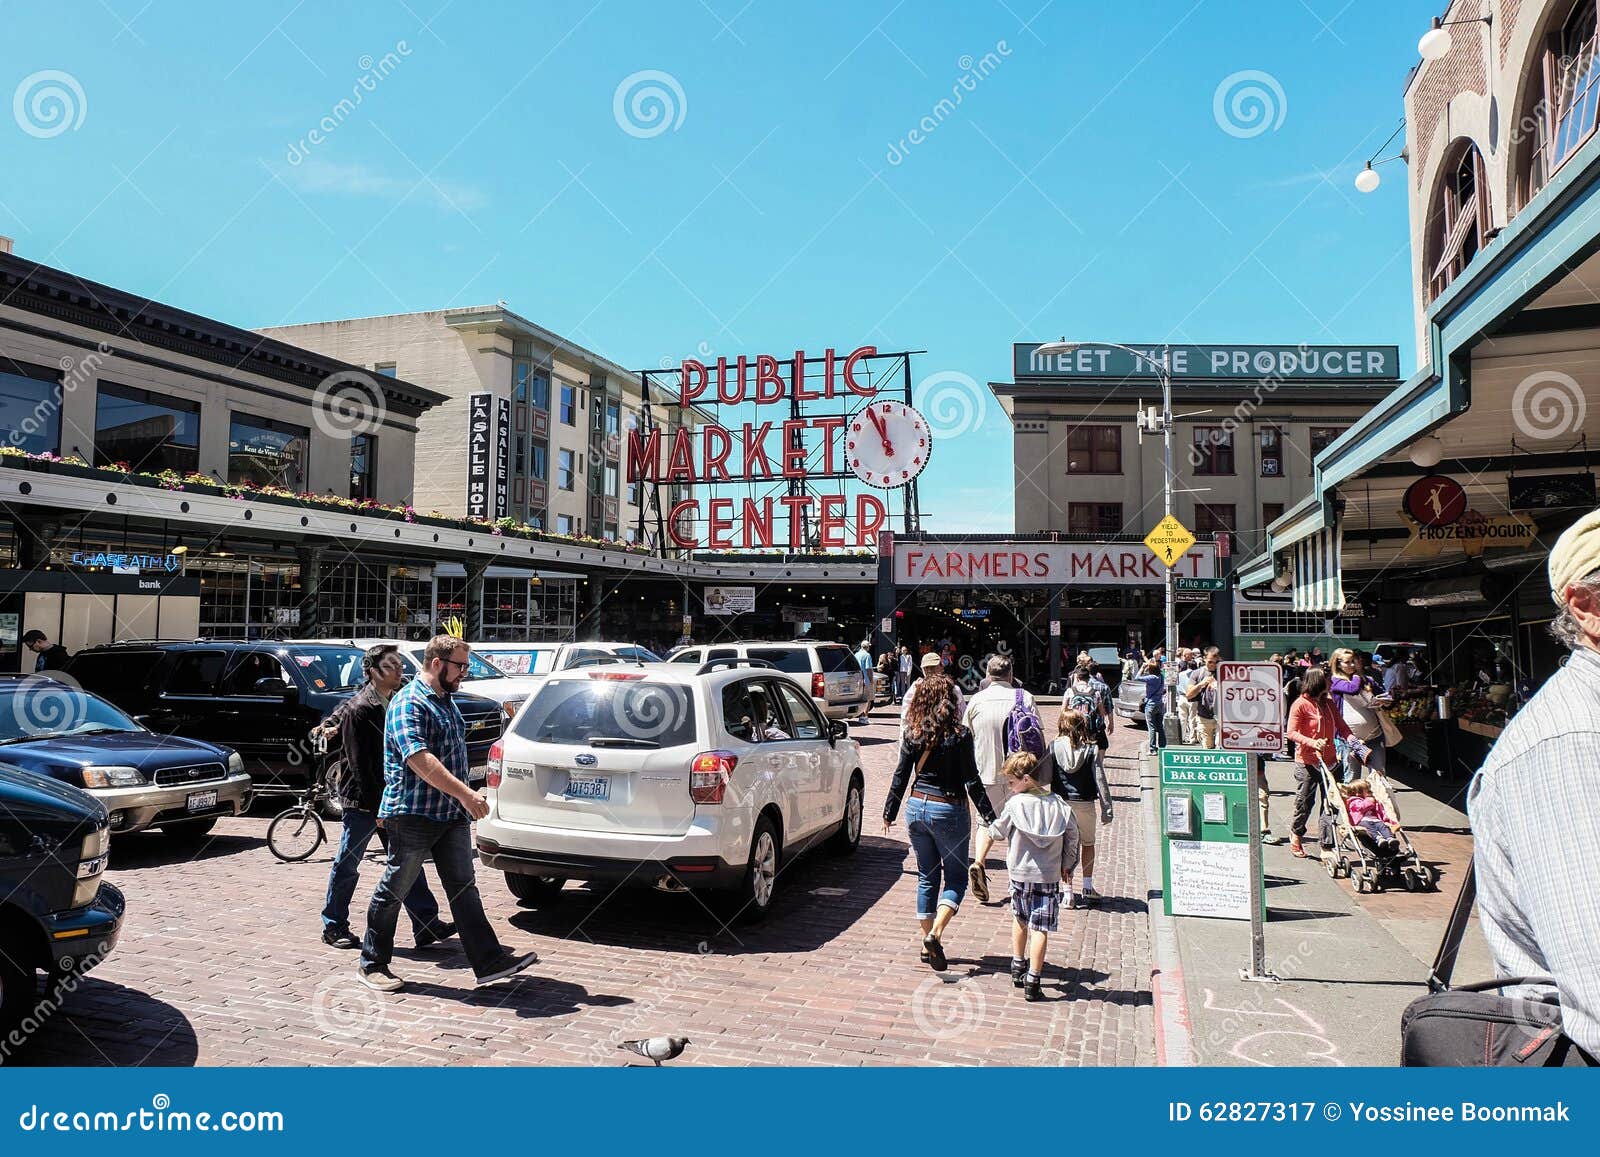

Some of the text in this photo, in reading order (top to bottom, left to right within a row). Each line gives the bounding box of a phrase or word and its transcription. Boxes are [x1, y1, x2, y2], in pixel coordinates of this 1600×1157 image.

[1030, 350, 1385, 374] MEET THE PRODUCER
[681, 346, 878, 408] PUBLIC
[882, 404, 891, 413] 12
[853, 423, 861, 432] 10
[914, 421, 920, 429] 2
[848, 441, 855, 450] 9
[919, 438, 925, 447] 3
[626, 416, 845, 484] MARKET
[470, 397, 487, 518] LA SALLE HOT
[496, 400, 508, 517] LA SALLE HOT
[913, 456, 920, 465] 4
[853, 459, 859, 468] 8
[866, 472, 872, 480] 7
[883, 476, 890, 484] 6
[902, 470, 908, 479] 5
[667, 493, 886, 549] CENTER
[1419, 523, 1532, 540] FROZEN YOGURT
[72, 551, 162, 568] CHASE ATM
[906, 552, 1049, 578] FARMERS
[139, 579, 161, 589] bank
[1180, 579, 1199, 588] Pike
[1224, 665, 1248, 681] NO
[1225, 687, 1277, 702] STOPS
[1172, 754, 1243, 765] PIKE PLACE
[1171, 771, 1247, 782] BAR & GRILL
